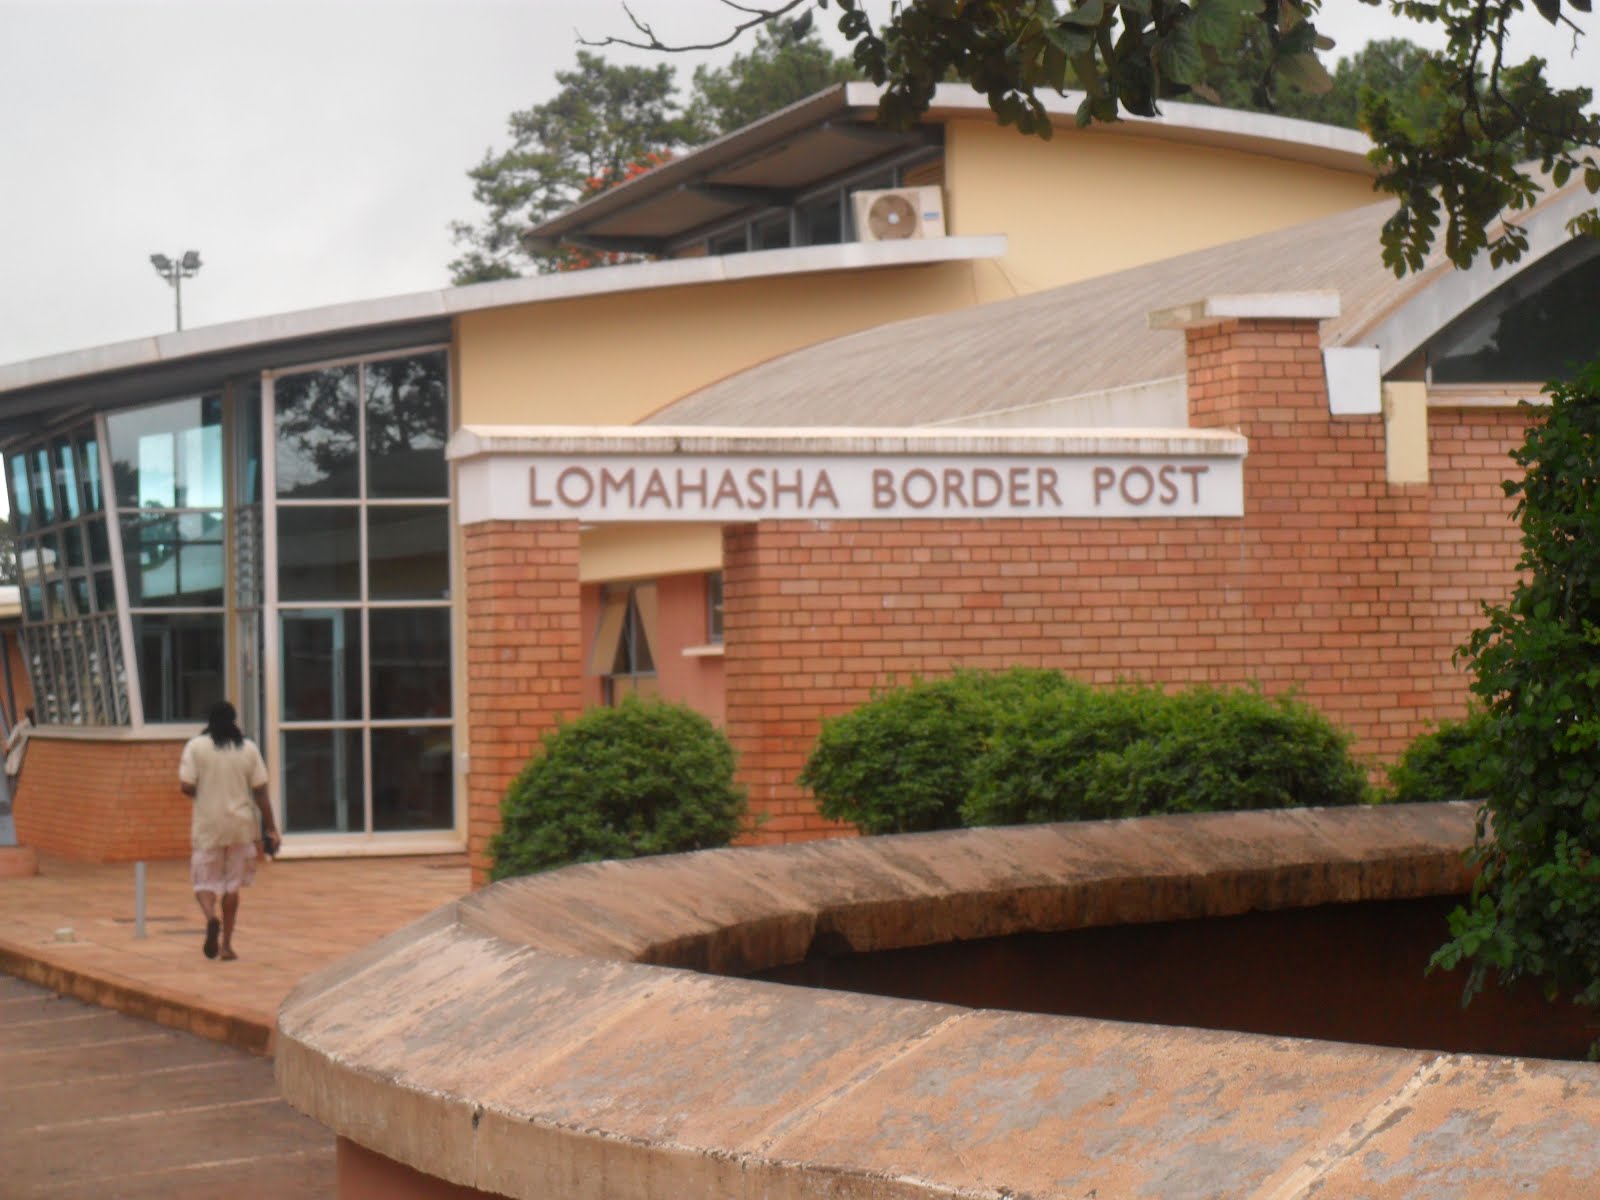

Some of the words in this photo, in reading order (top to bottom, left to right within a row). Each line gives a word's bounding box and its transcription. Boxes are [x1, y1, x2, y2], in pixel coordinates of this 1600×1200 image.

[529, 466, 840, 509] LOMAHASHA
[872, 467, 1063, 509] BORDER
[1093, 464, 1210, 505] POST
